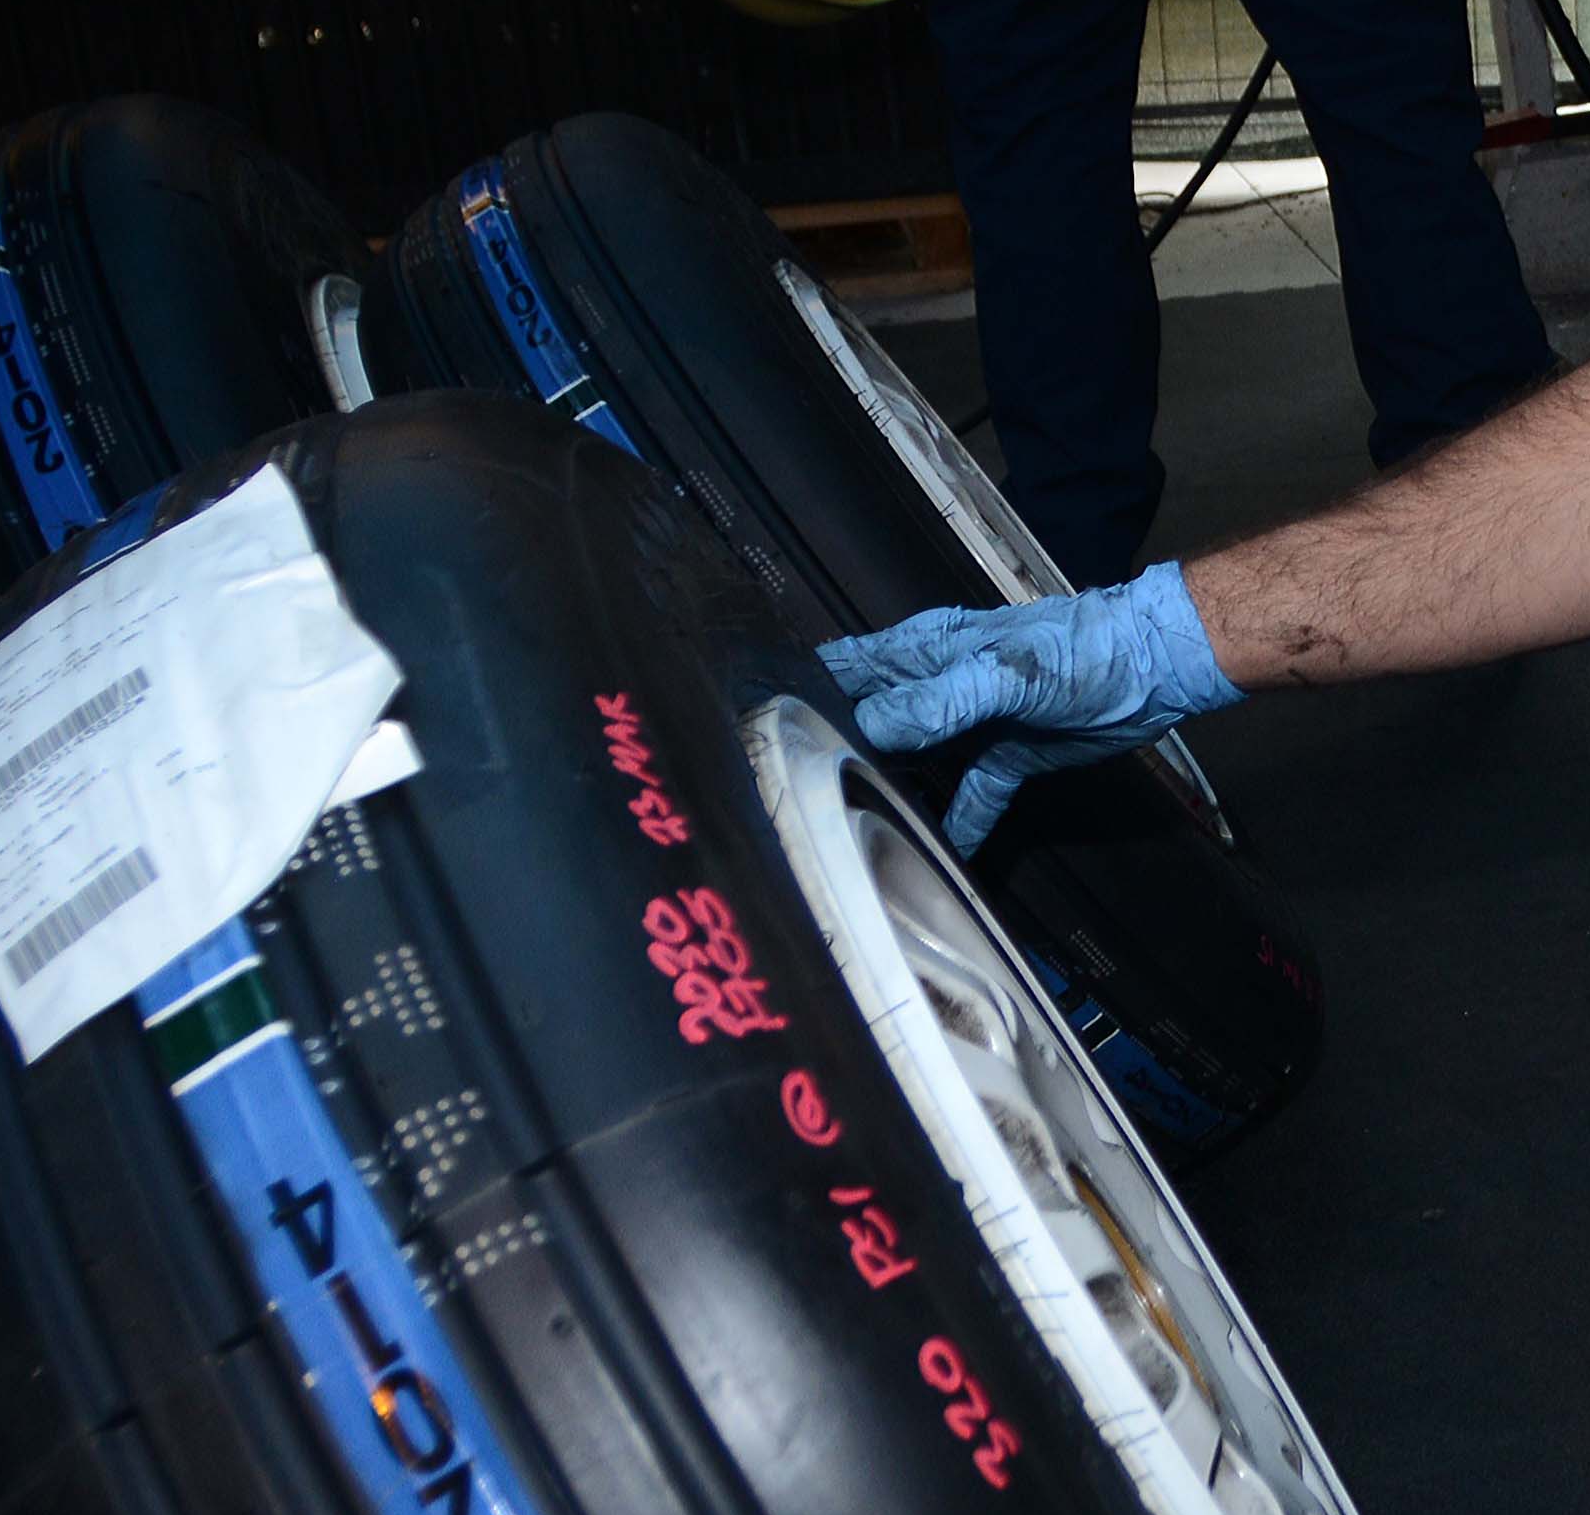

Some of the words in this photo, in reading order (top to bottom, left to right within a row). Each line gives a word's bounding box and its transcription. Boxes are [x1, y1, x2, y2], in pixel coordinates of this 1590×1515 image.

[489, 239, 551, 348] 2014
[780, 1066, 847, 1148] @
[829, 1184, 919, 1291] PSI
[917, 1334, 1026, 1492] 320
